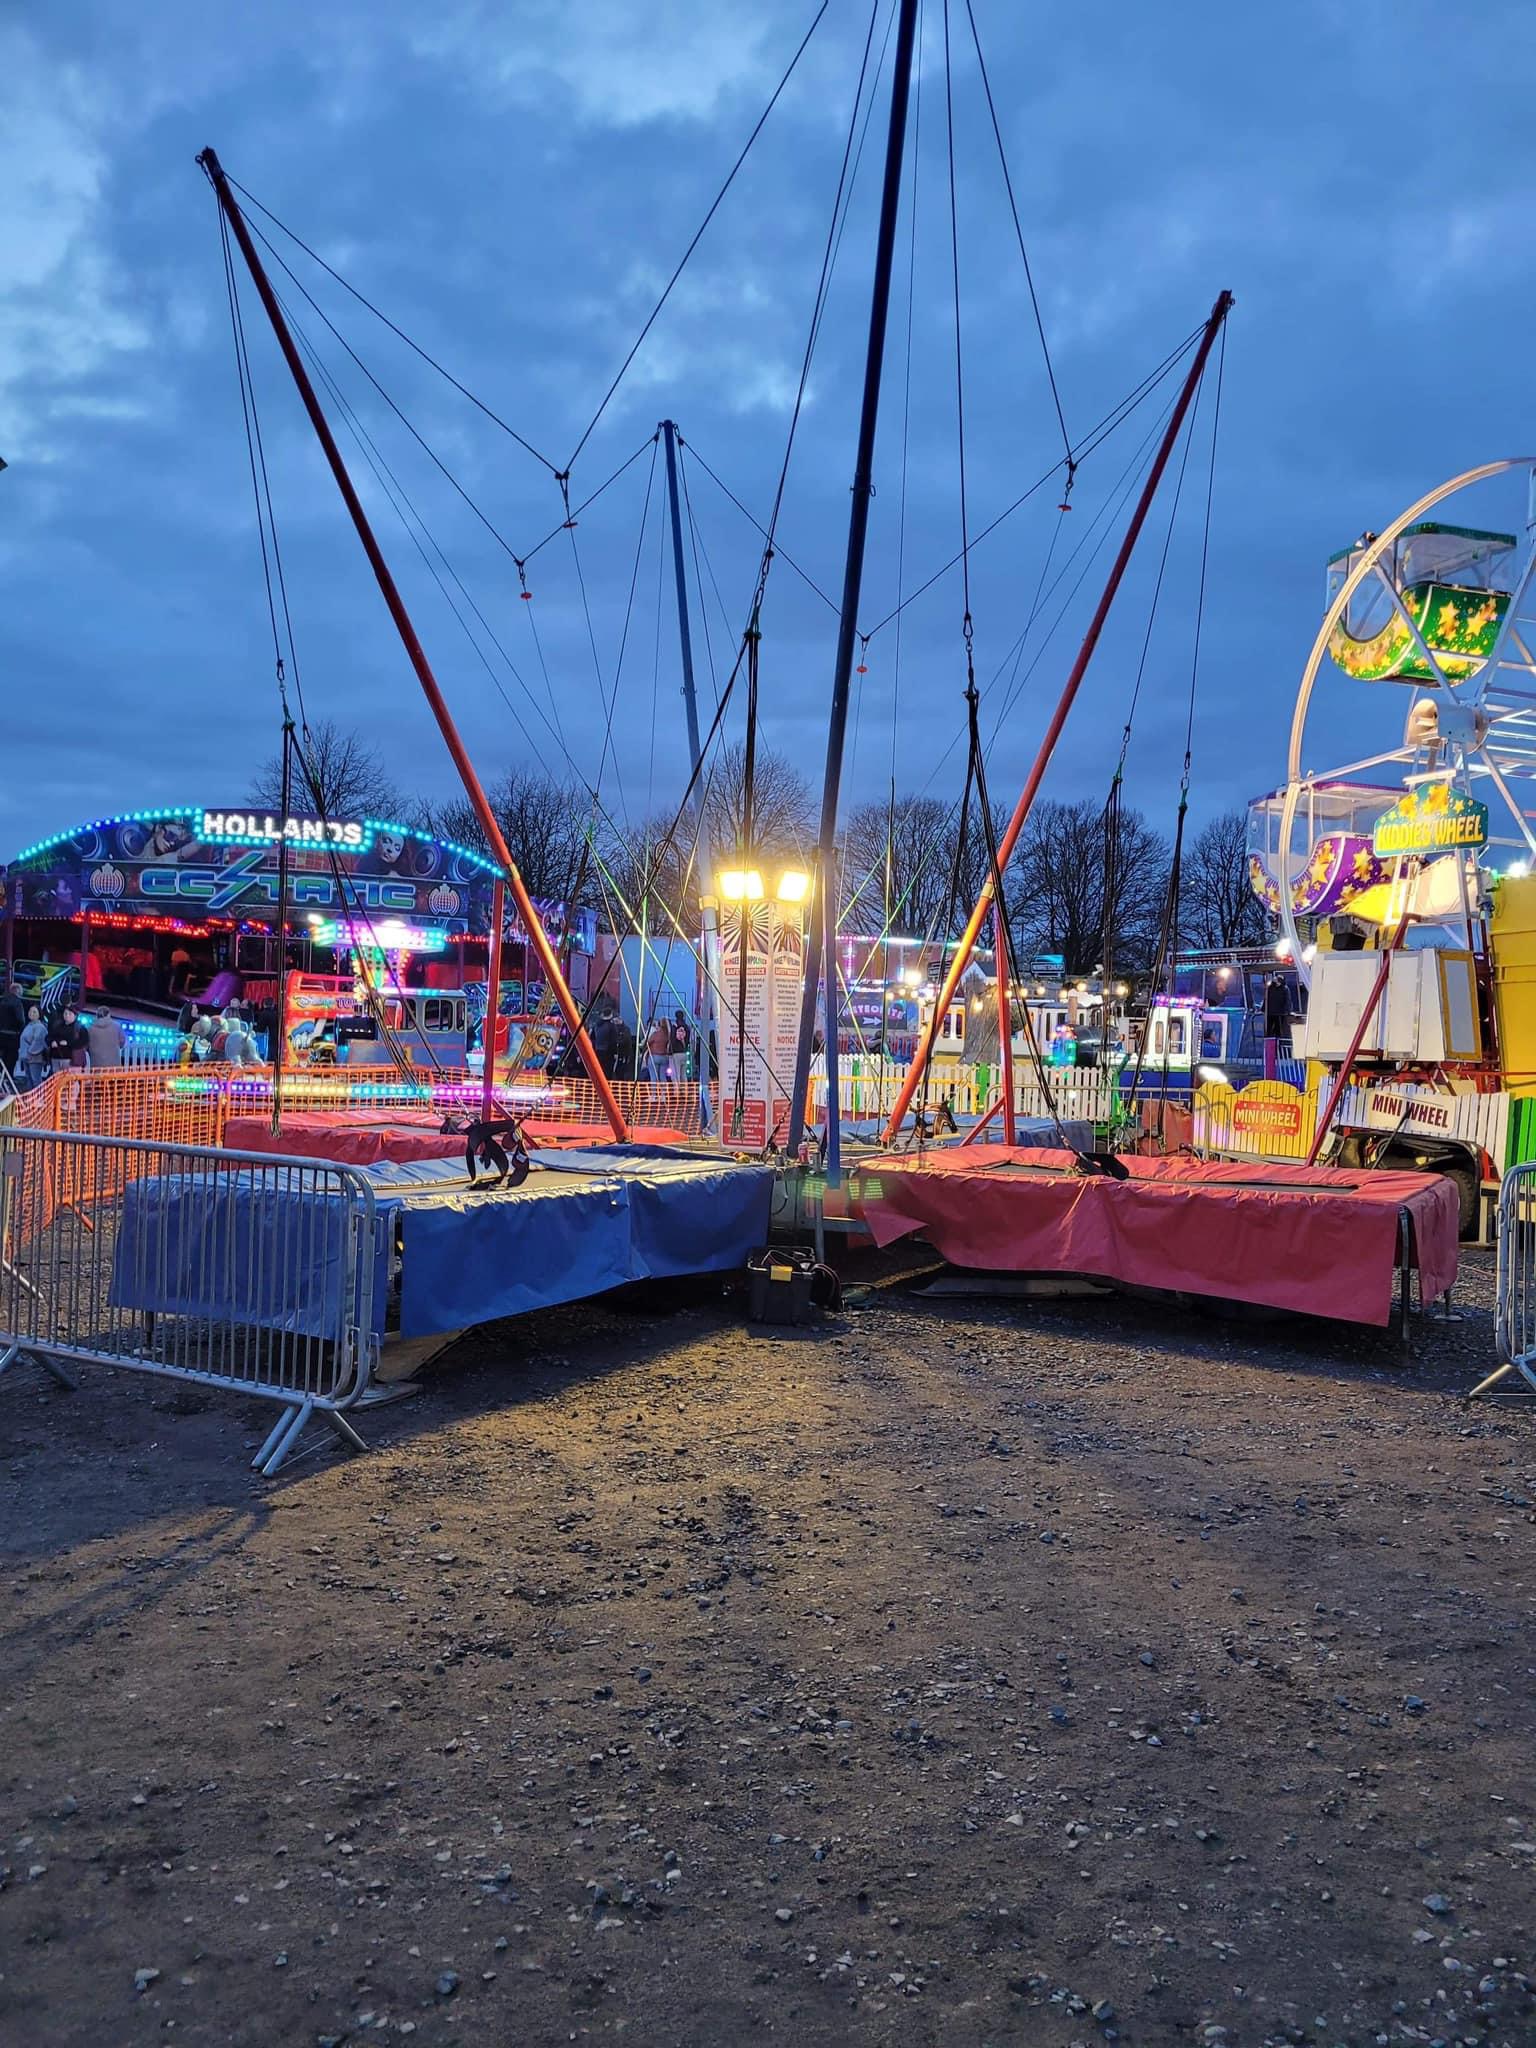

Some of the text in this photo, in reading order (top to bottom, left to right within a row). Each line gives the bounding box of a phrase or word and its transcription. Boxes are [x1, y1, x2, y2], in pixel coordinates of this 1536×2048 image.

[203, 813, 362, 845] HOLLANDS
[1376, 815, 1484, 851] KIDDIES WHEEL
[1235, 1108, 1297, 1128] MINI WHEEL
[1372, 1094, 1449, 1129] MINI WHEEL
